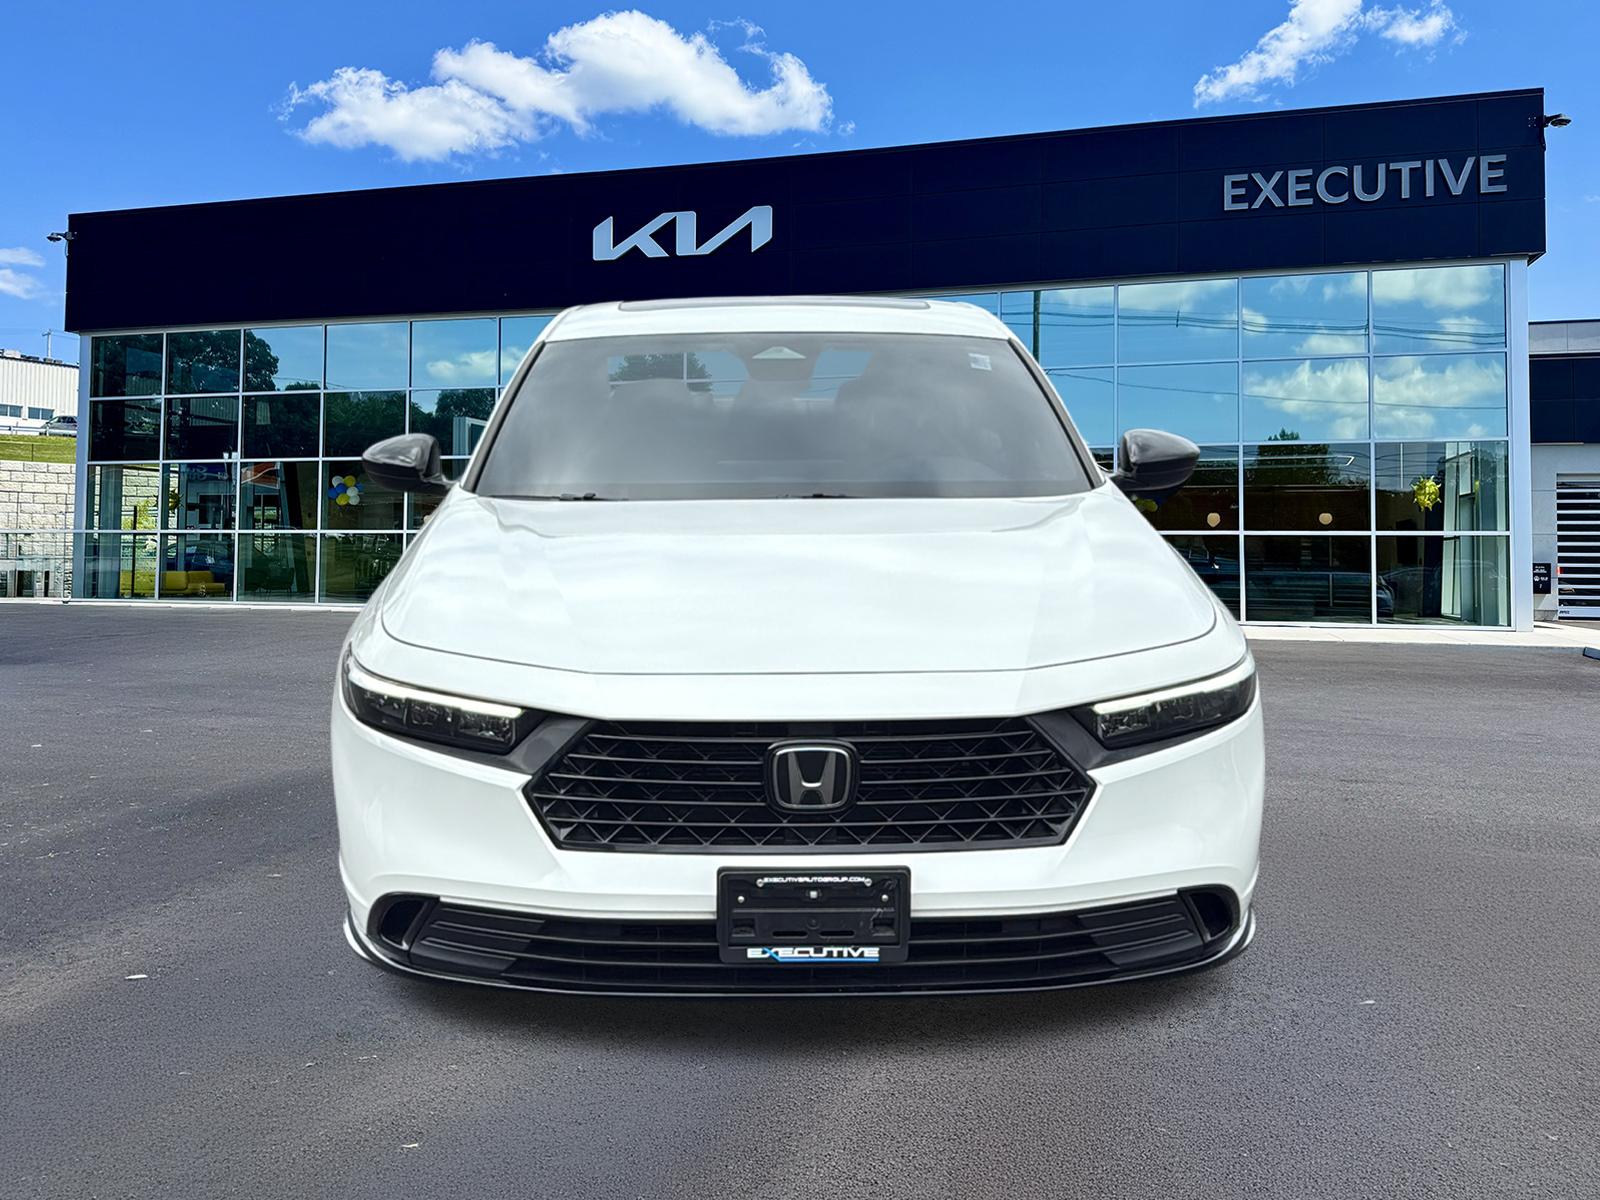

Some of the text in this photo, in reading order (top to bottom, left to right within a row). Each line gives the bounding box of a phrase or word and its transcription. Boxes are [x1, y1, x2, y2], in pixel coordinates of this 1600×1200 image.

[1224, 154, 1508, 211] EXECUTIVE
[593, 205, 773, 261] KIA
[747, 947, 880, 959] EXECUTIVE
